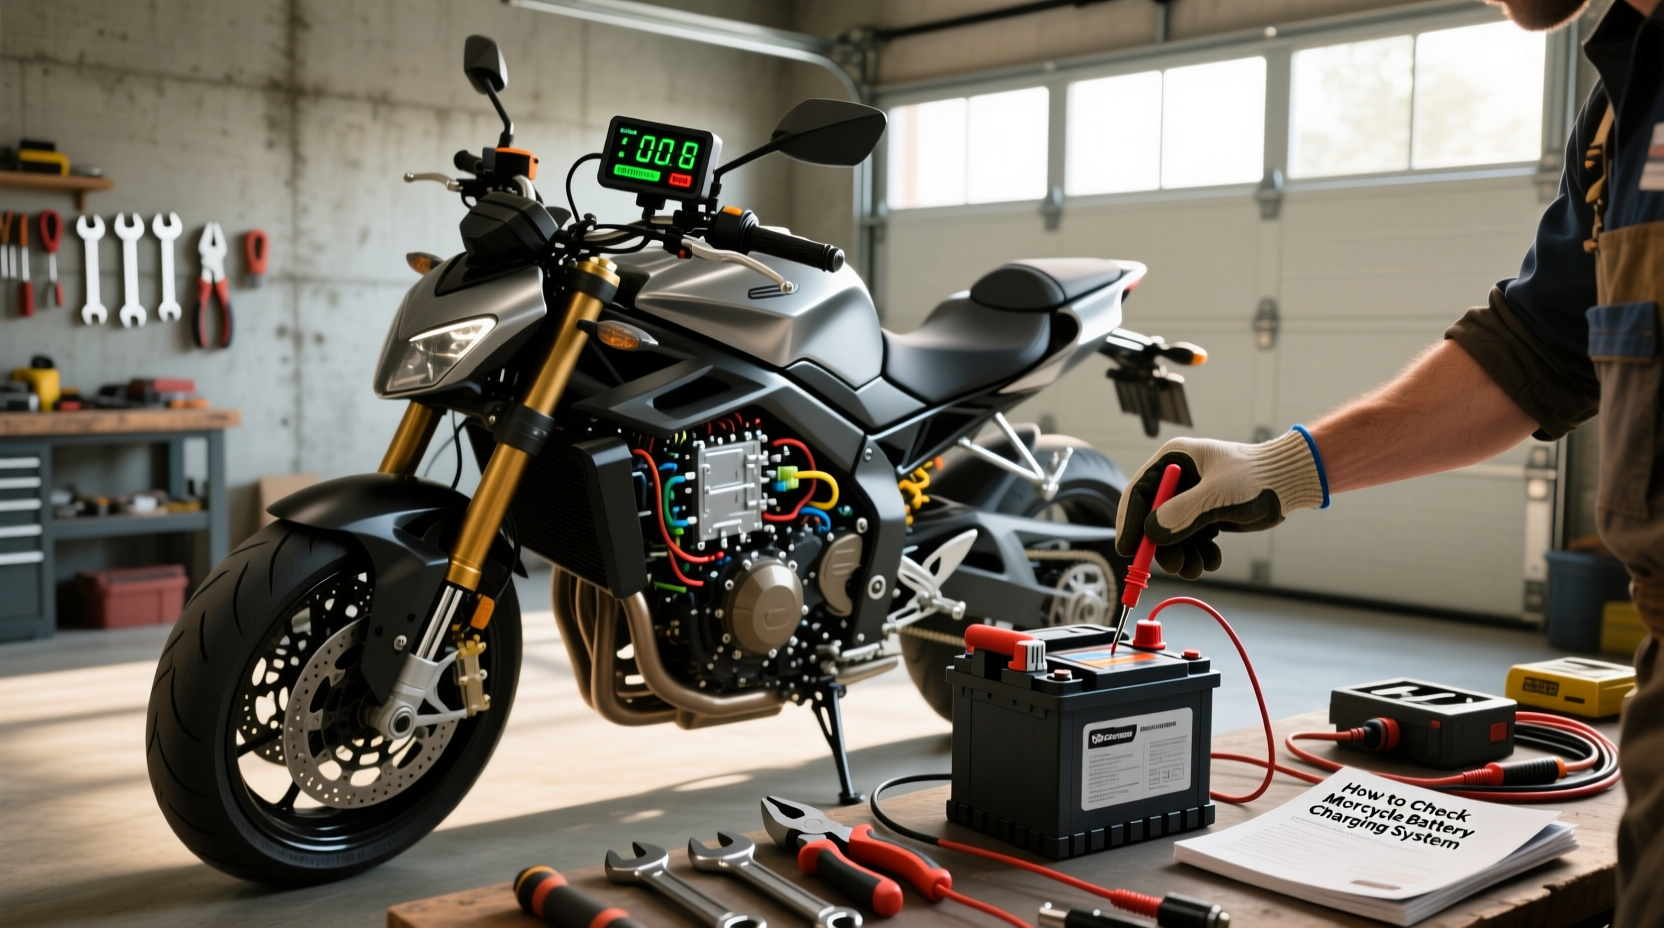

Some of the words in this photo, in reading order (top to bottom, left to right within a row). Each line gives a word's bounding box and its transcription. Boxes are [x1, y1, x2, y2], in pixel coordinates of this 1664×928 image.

[1322, 793, 1404, 822] Morcycle
[1405, 814, 1475, 839] Battery
[1341, 782, 1385, 801] How
[1387, 793, 1406, 807] to
[1410, 800, 1471, 822] Check
[1309, 804, 1390, 835] Charging
[1391, 825, 1460, 850] System
